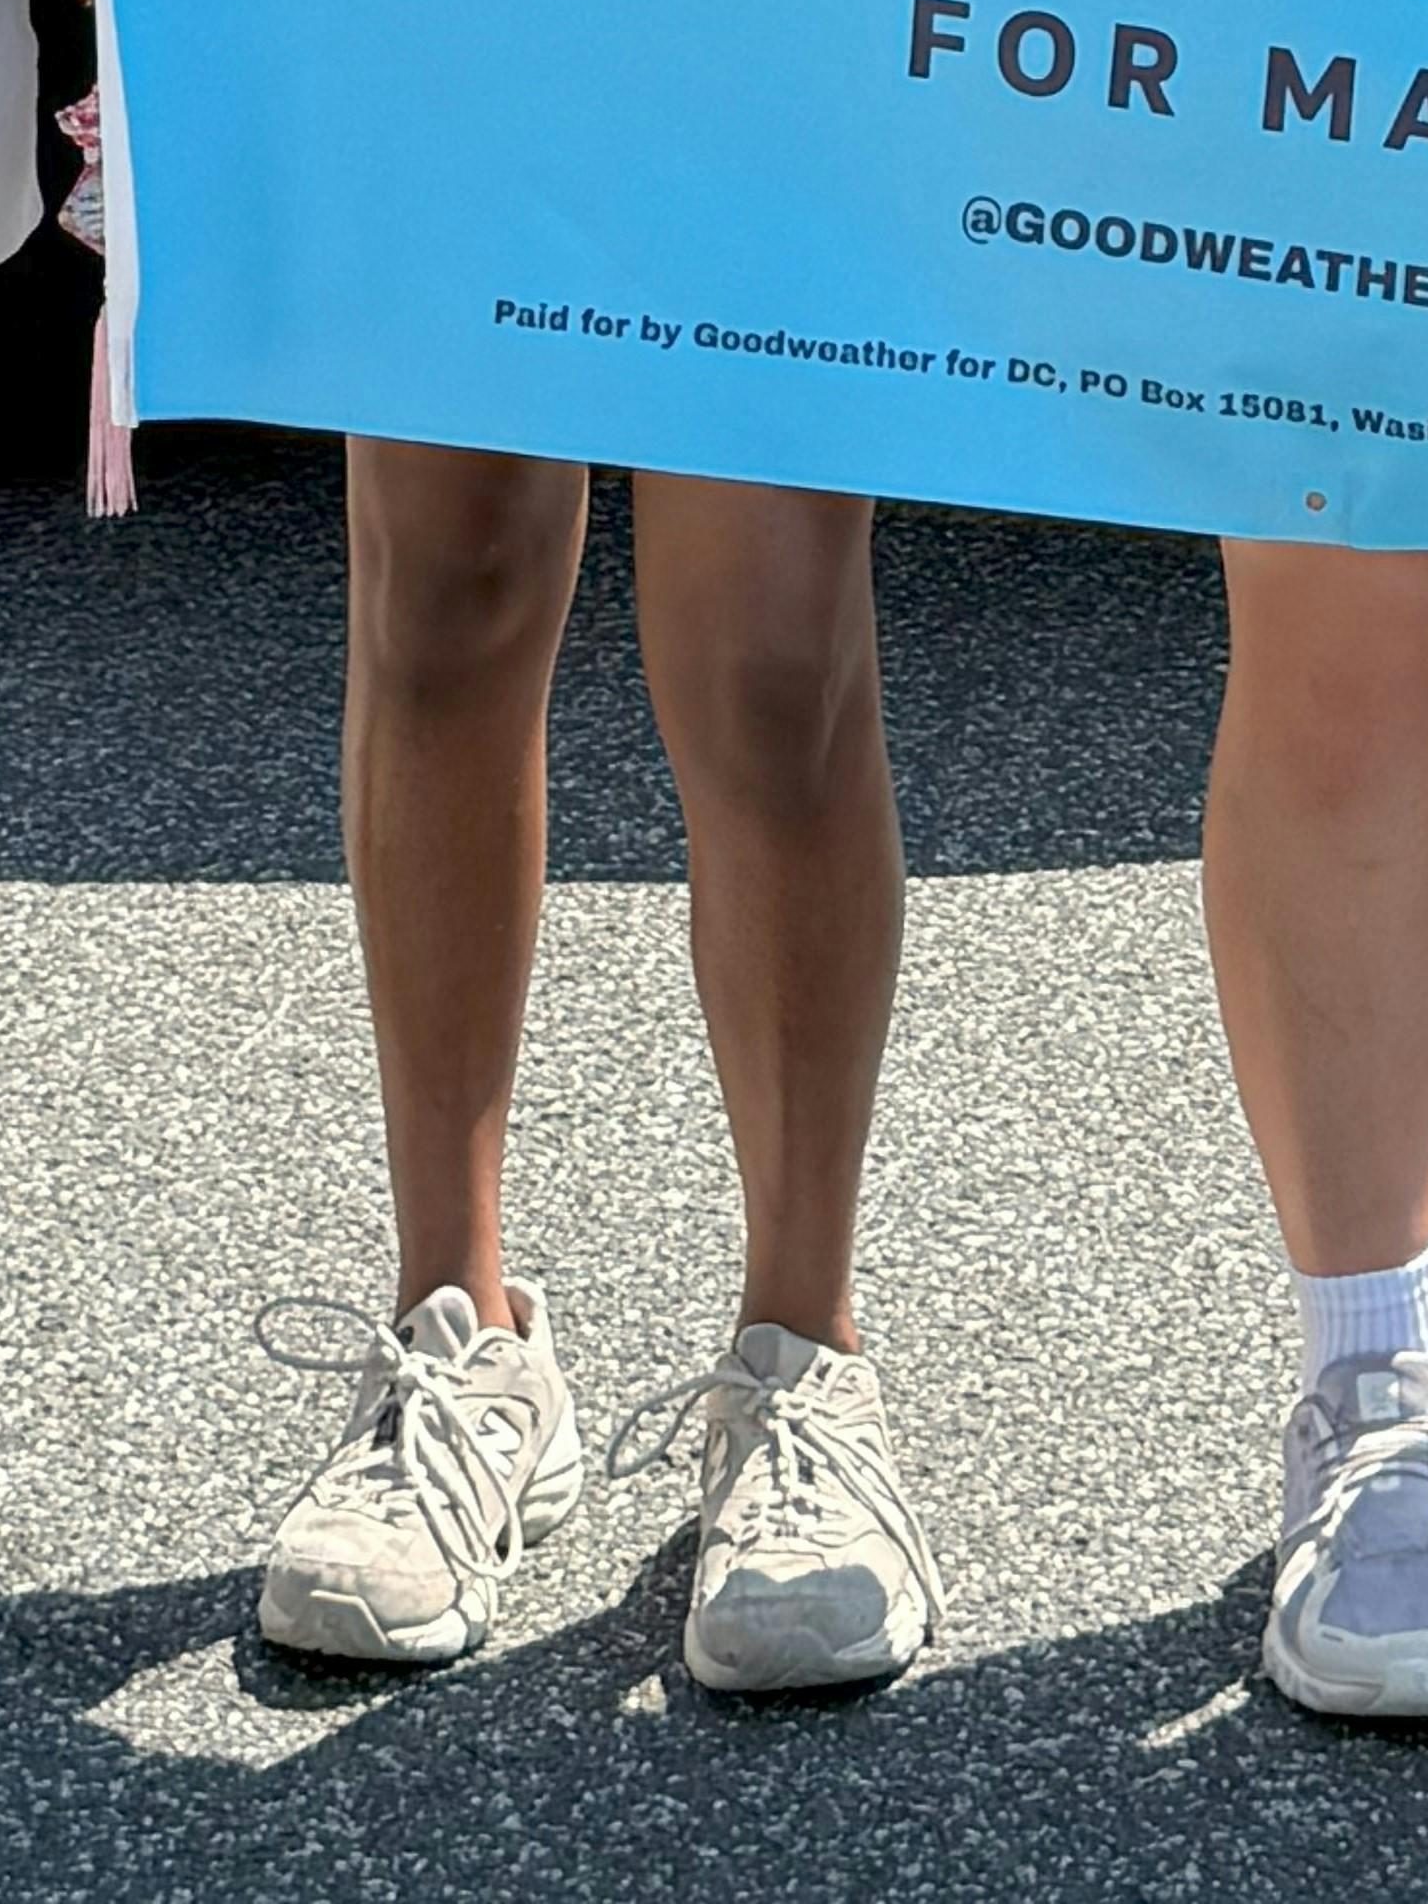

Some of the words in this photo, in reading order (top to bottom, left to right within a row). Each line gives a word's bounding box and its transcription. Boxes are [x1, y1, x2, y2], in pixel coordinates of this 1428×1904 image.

[494, 299, 570, 332] Paid
[581, 308, 631, 338] for
[640, 314, 682, 349] by
[693, 322, 937, 374] Goodweather
[946, 348, 997, 380] for
[1007, 357, 1068, 394] DC,
[1080, 369, 1128, 398] PO
[1141, 379, 1205, 413] Box
[1219, 392, 1339, 433] 15081,
